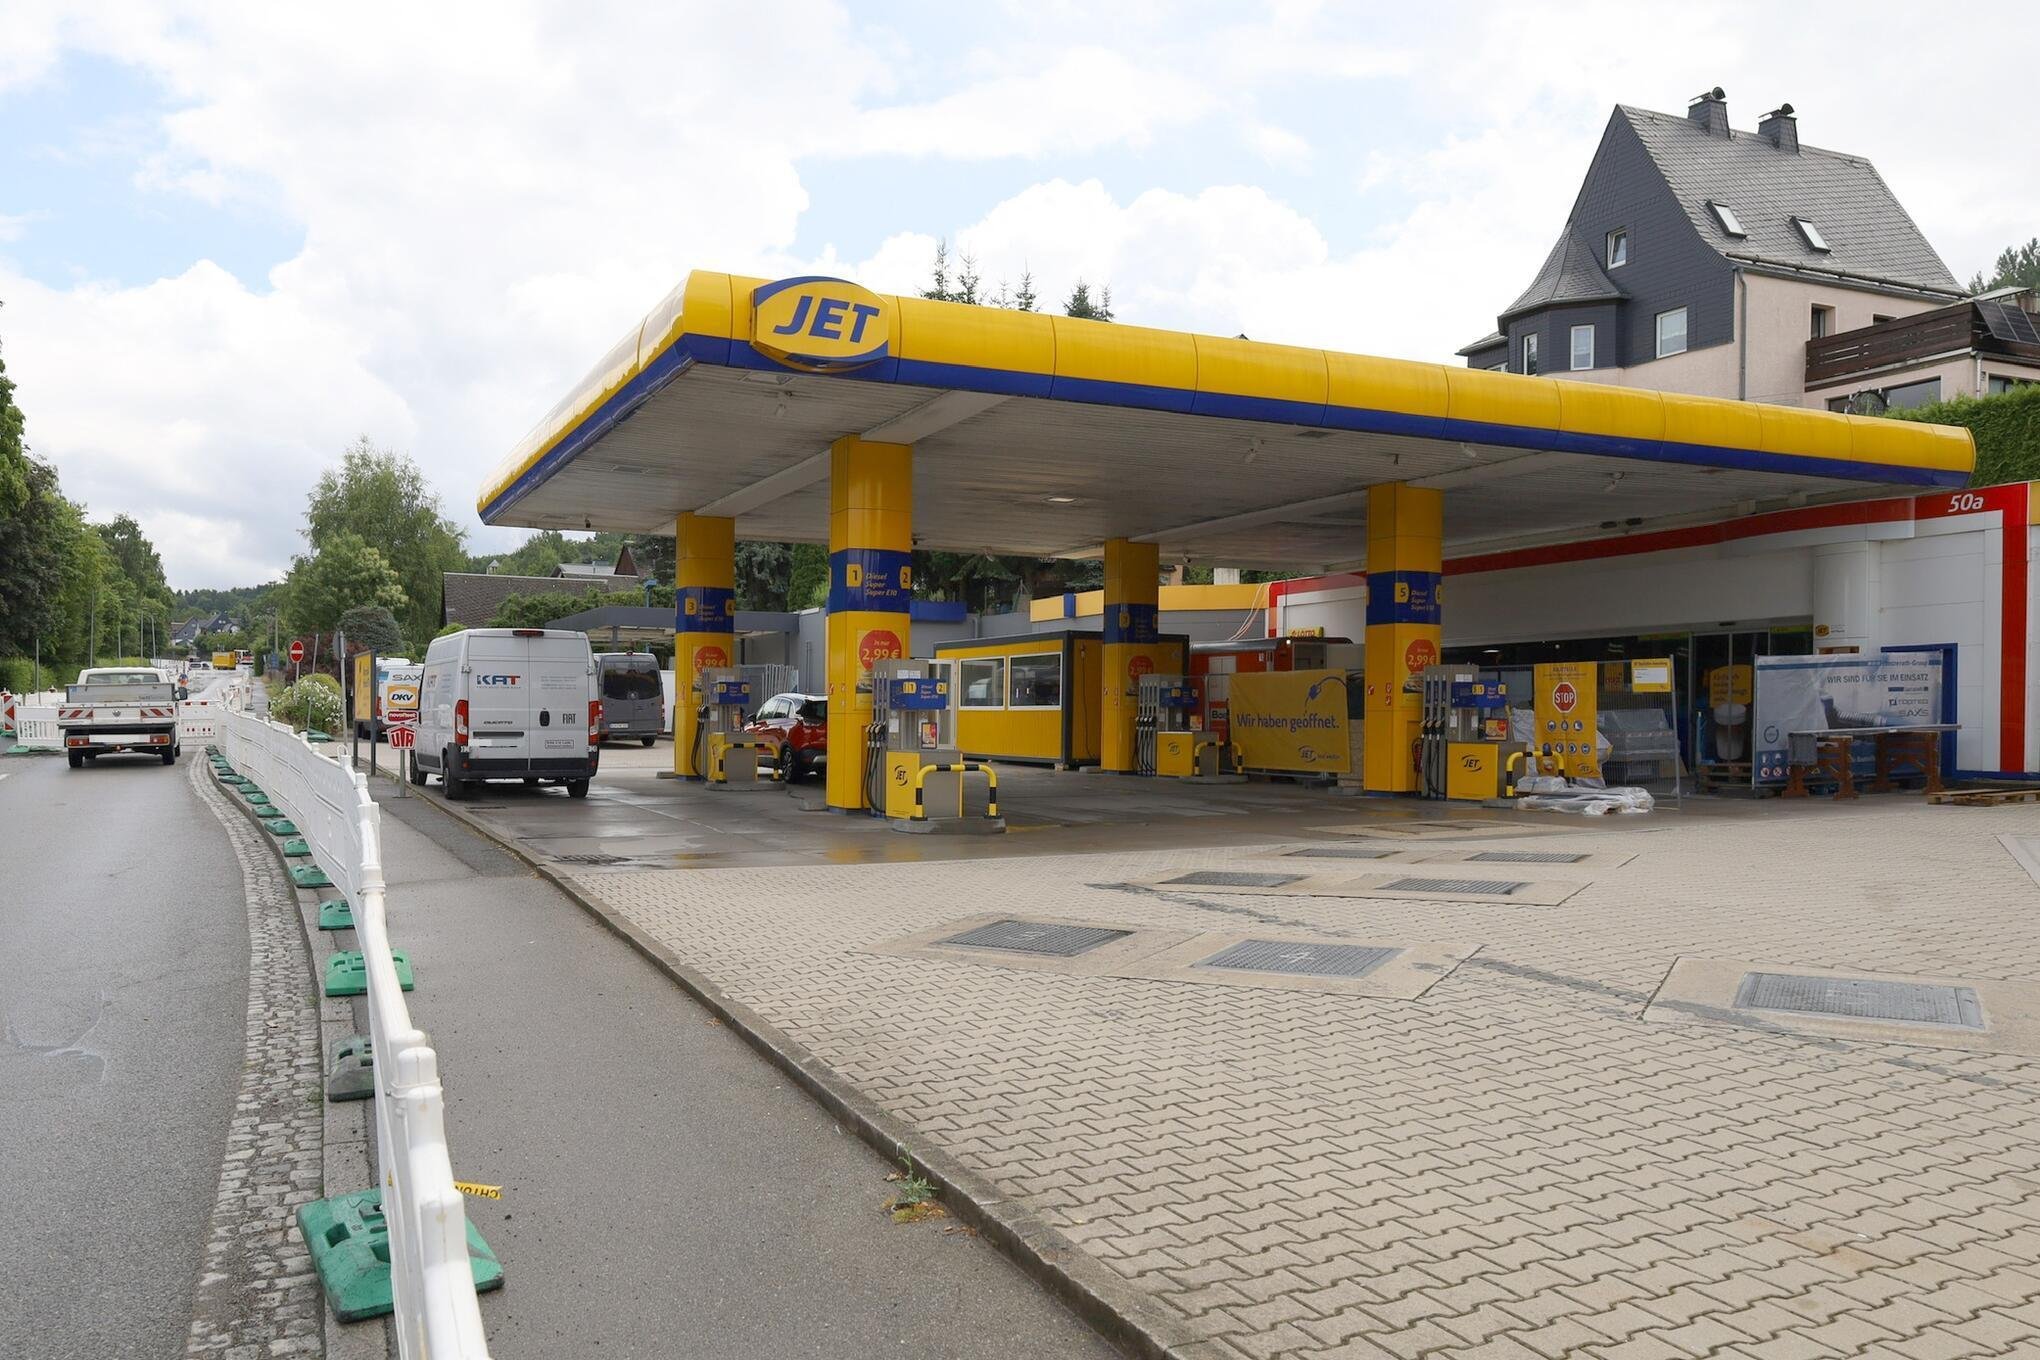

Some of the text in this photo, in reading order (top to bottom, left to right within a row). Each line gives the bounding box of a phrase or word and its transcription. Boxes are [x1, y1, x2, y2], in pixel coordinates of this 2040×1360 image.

[773, 295, 880, 343] JET
[1948, 493, 1984, 512] 50a
[852, 570, 858, 581] 1
[865, 572, 888, 580] Diesel
[902, 572, 909, 583] 2
[865, 581, 886, 589] Super
[865, 589, 885, 597] Super
[1400, 588, 1406, 597] 5
[477, 675, 520, 685] KAT
[1843, 675, 1860, 683] SIND
[1878, 674, 1888, 682] SIE
[1900, 673, 1928, 681] EINSATZ
[391, 693, 413, 701] DKV
[1555, 692, 1575, 704] STOP
[562, 713, 576, 724] FIAT
[1237, 713, 1340, 733] Wir haben geöffnet.
[390, 727, 415, 747] UTA
[1464, 760, 1480, 768] JET
[896, 771, 907, 780] JET
